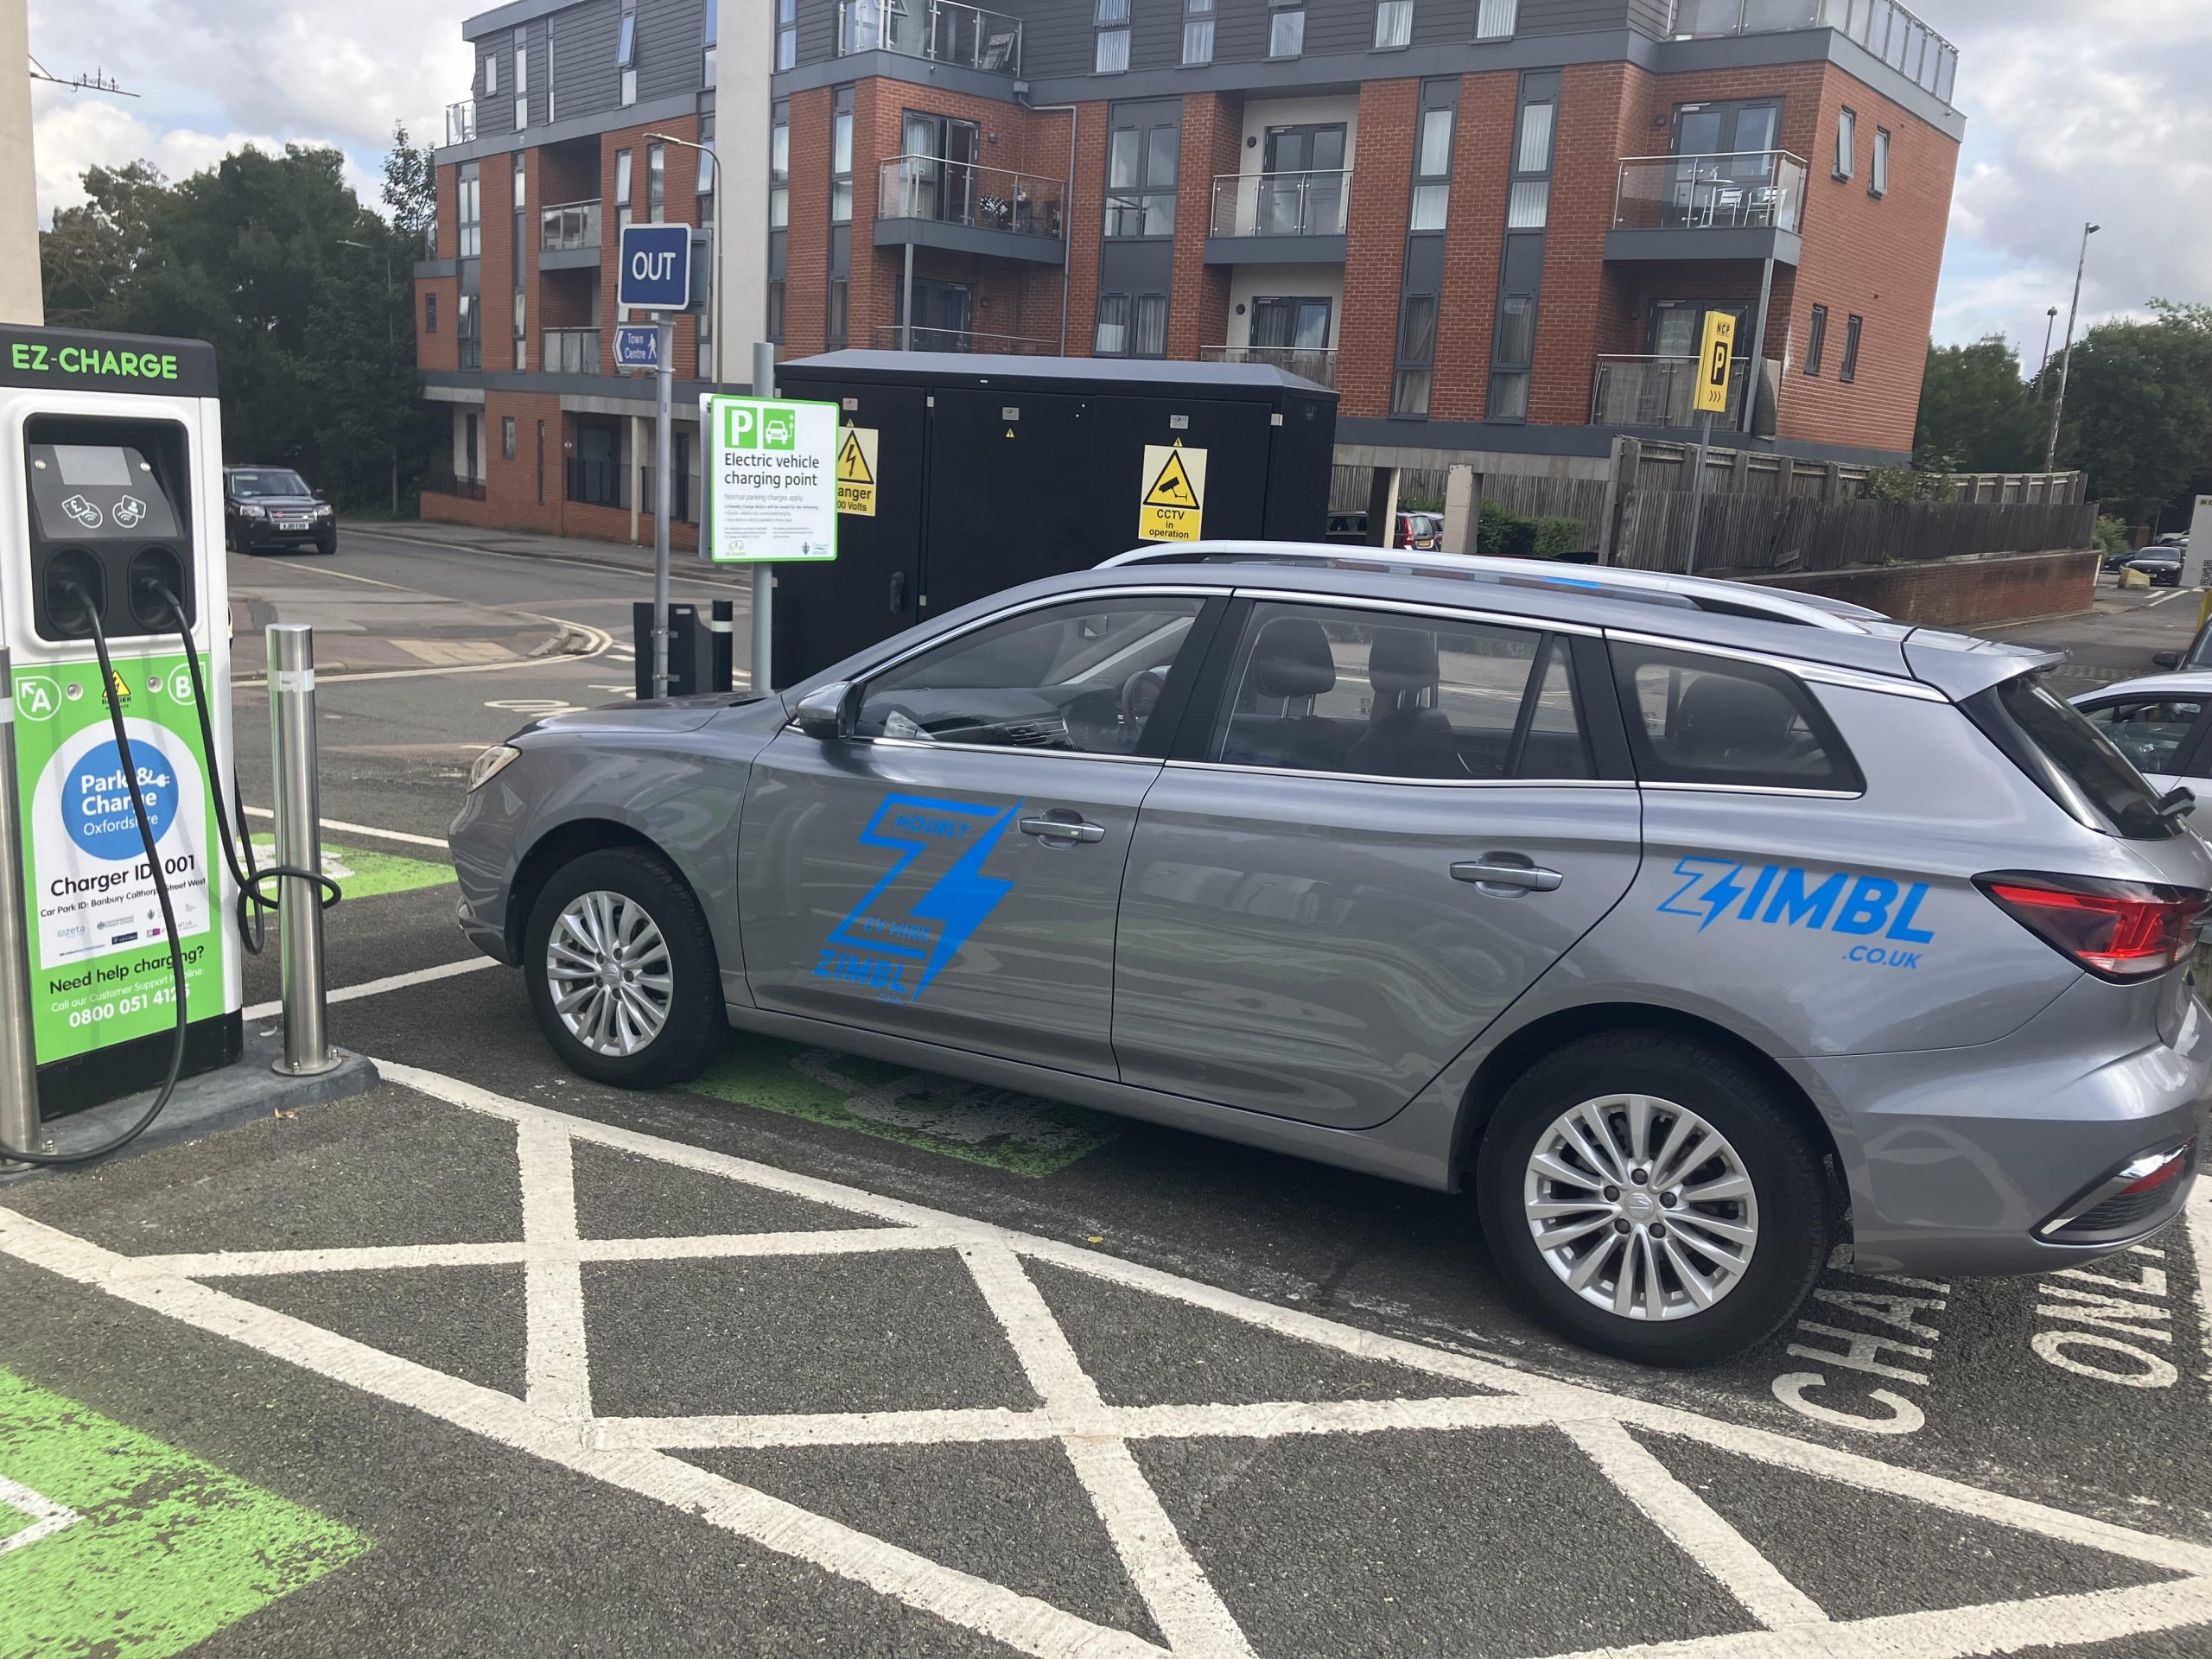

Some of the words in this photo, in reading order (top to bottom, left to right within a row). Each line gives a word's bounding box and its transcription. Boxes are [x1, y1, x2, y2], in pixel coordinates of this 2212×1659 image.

[632, 251, 676, 281] OUT
[627, 333, 644, 345] Town
[1716, 321, 1731, 335] NCP
[12, 344, 178, 379] EZ-CHARGE
[624, 347, 646, 359] Centre
[1713, 346, 1726, 380] P
[731, 410, 753, 446] P
[724, 453, 773, 467] Electric
[776, 454, 820, 468] vehicle
[724, 471, 781, 488] charging
[785, 473, 818, 489] point
[836, 500, 846, 509] 00
[848, 502, 868, 511] Volts
[837, 487, 872, 501] anger
[1156, 509, 1185, 520] CCTV
[1149, 529, 1189, 539] operation
[175, 676, 192, 698] B
[31, 688, 52, 713] A
[81, 769, 129, 795] Park
[82, 791, 157, 816] Chare
[83, 815, 159, 836] Oxfordsre
[893, 815, 973, 840] HOURLY
[51, 869, 130, 896] Charger
[165, 855, 195, 874] 001
[41, 908, 56, 918] Car
[57, 903, 77, 915] Park
[78, 900, 89, 910] ID:
[91, 893, 124, 907] Banbury
[126, 887, 158, 900] Calthorp
[188, 877, 206, 888] West
[1656, 856, 1935, 944] ZIMBL
[864, 917, 887, 933] EV
[890, 921, 934, 943] HIRE
[50, 970, 92, 995] Need
[97, 963, 129, 982] help
[134, 945, 204, 974] chargng?
[810, 949, 907, 994] ZIMBL
[51, 999, 69, 1013] Call
[72, 997, 86, 1007] our
[90, 985, 132, 1002] Customer
[135, 976, 168, 991] Support
[69, 1002, 115, 1027] 0800
[119, 994, 148, 1014] 051
